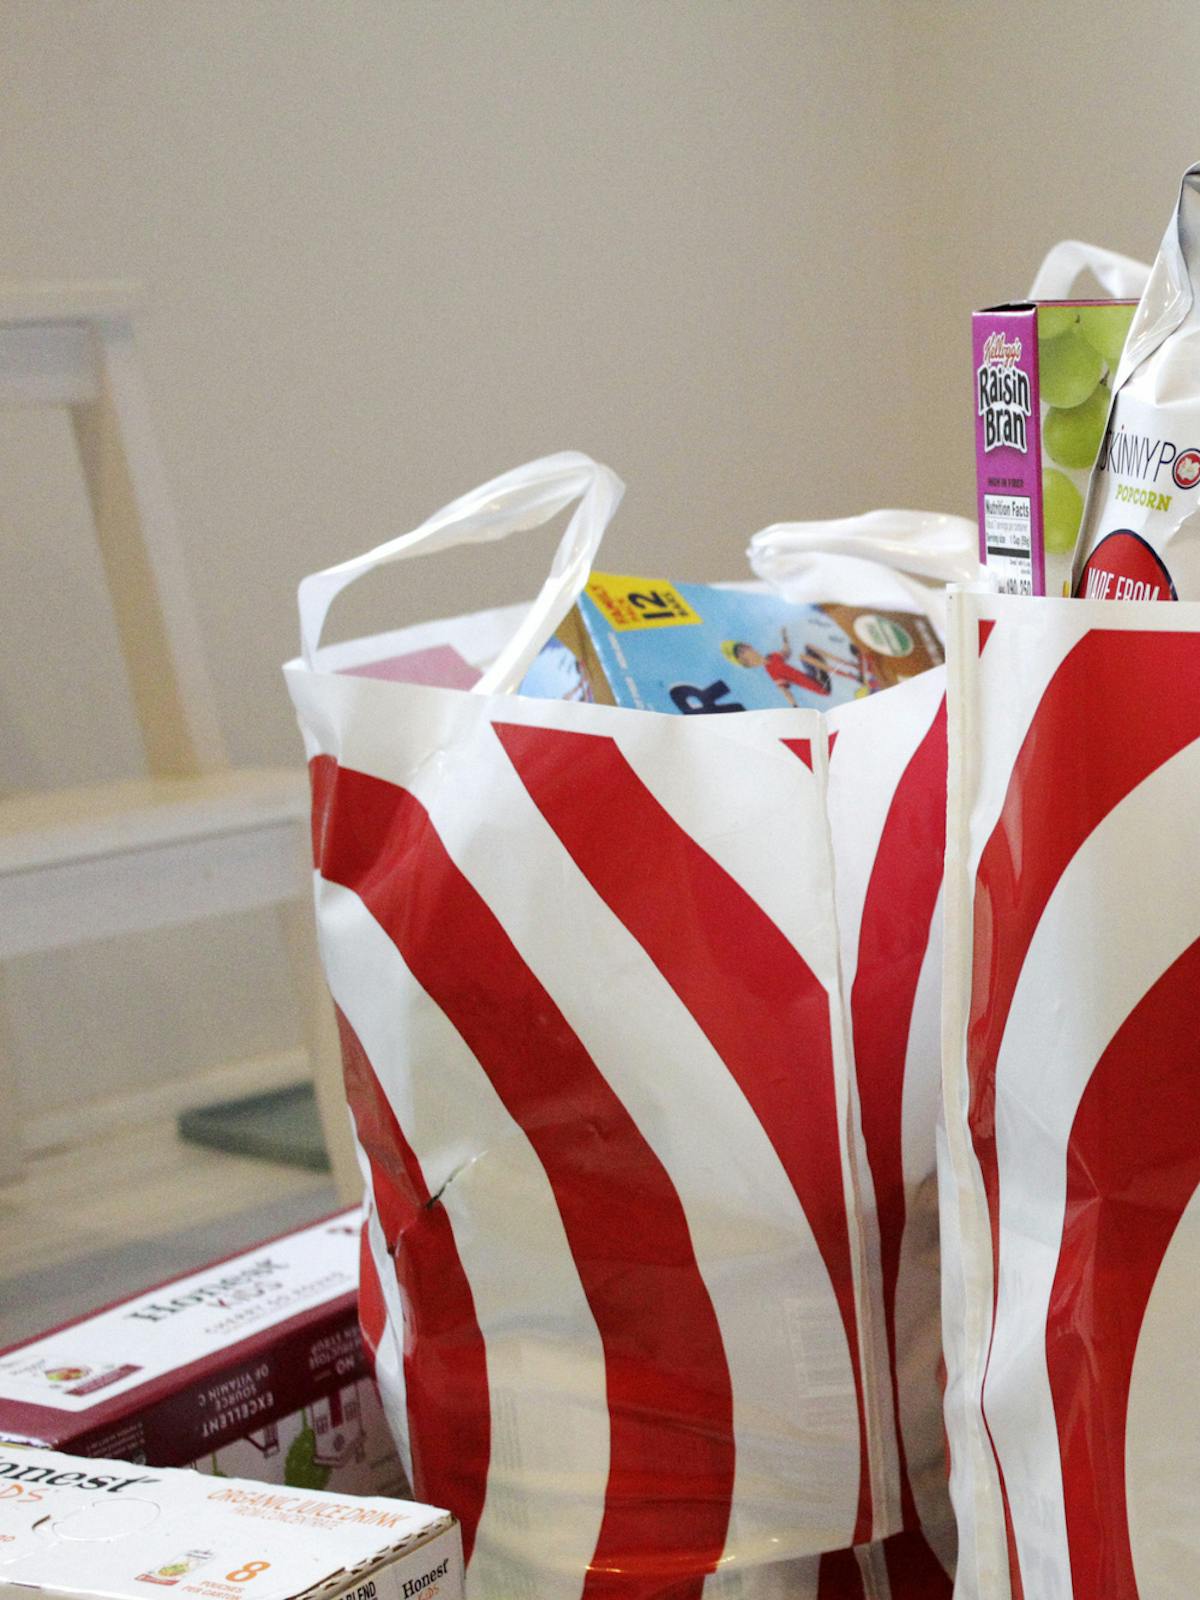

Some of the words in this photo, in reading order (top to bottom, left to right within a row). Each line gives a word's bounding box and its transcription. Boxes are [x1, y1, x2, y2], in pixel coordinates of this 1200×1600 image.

[979, 366, 1029, 413] Raisin
[986, 407, 1026, 450] Bran
[1012, 501, 1030, 518] Facts
[1114, 484, 1173, 512] POPCORN
[1115, 576, 1160, 601] FROM
[627, 589, 676, 620] 12
[208, 1372, 252, 1399] VITAMIN
[202, 1391, 275, 1437] EXCELLENT
[0, 1462, 161, 1493] onest
[208, 1488, 299, 1512] ORGANIC
[288, 1497, 350, 1519] JUICE
[341, 1505, 411, 1529] DRINK
[225, 1561, 271, 1583] 8
[402, 1558, 449, 1600] Honest
